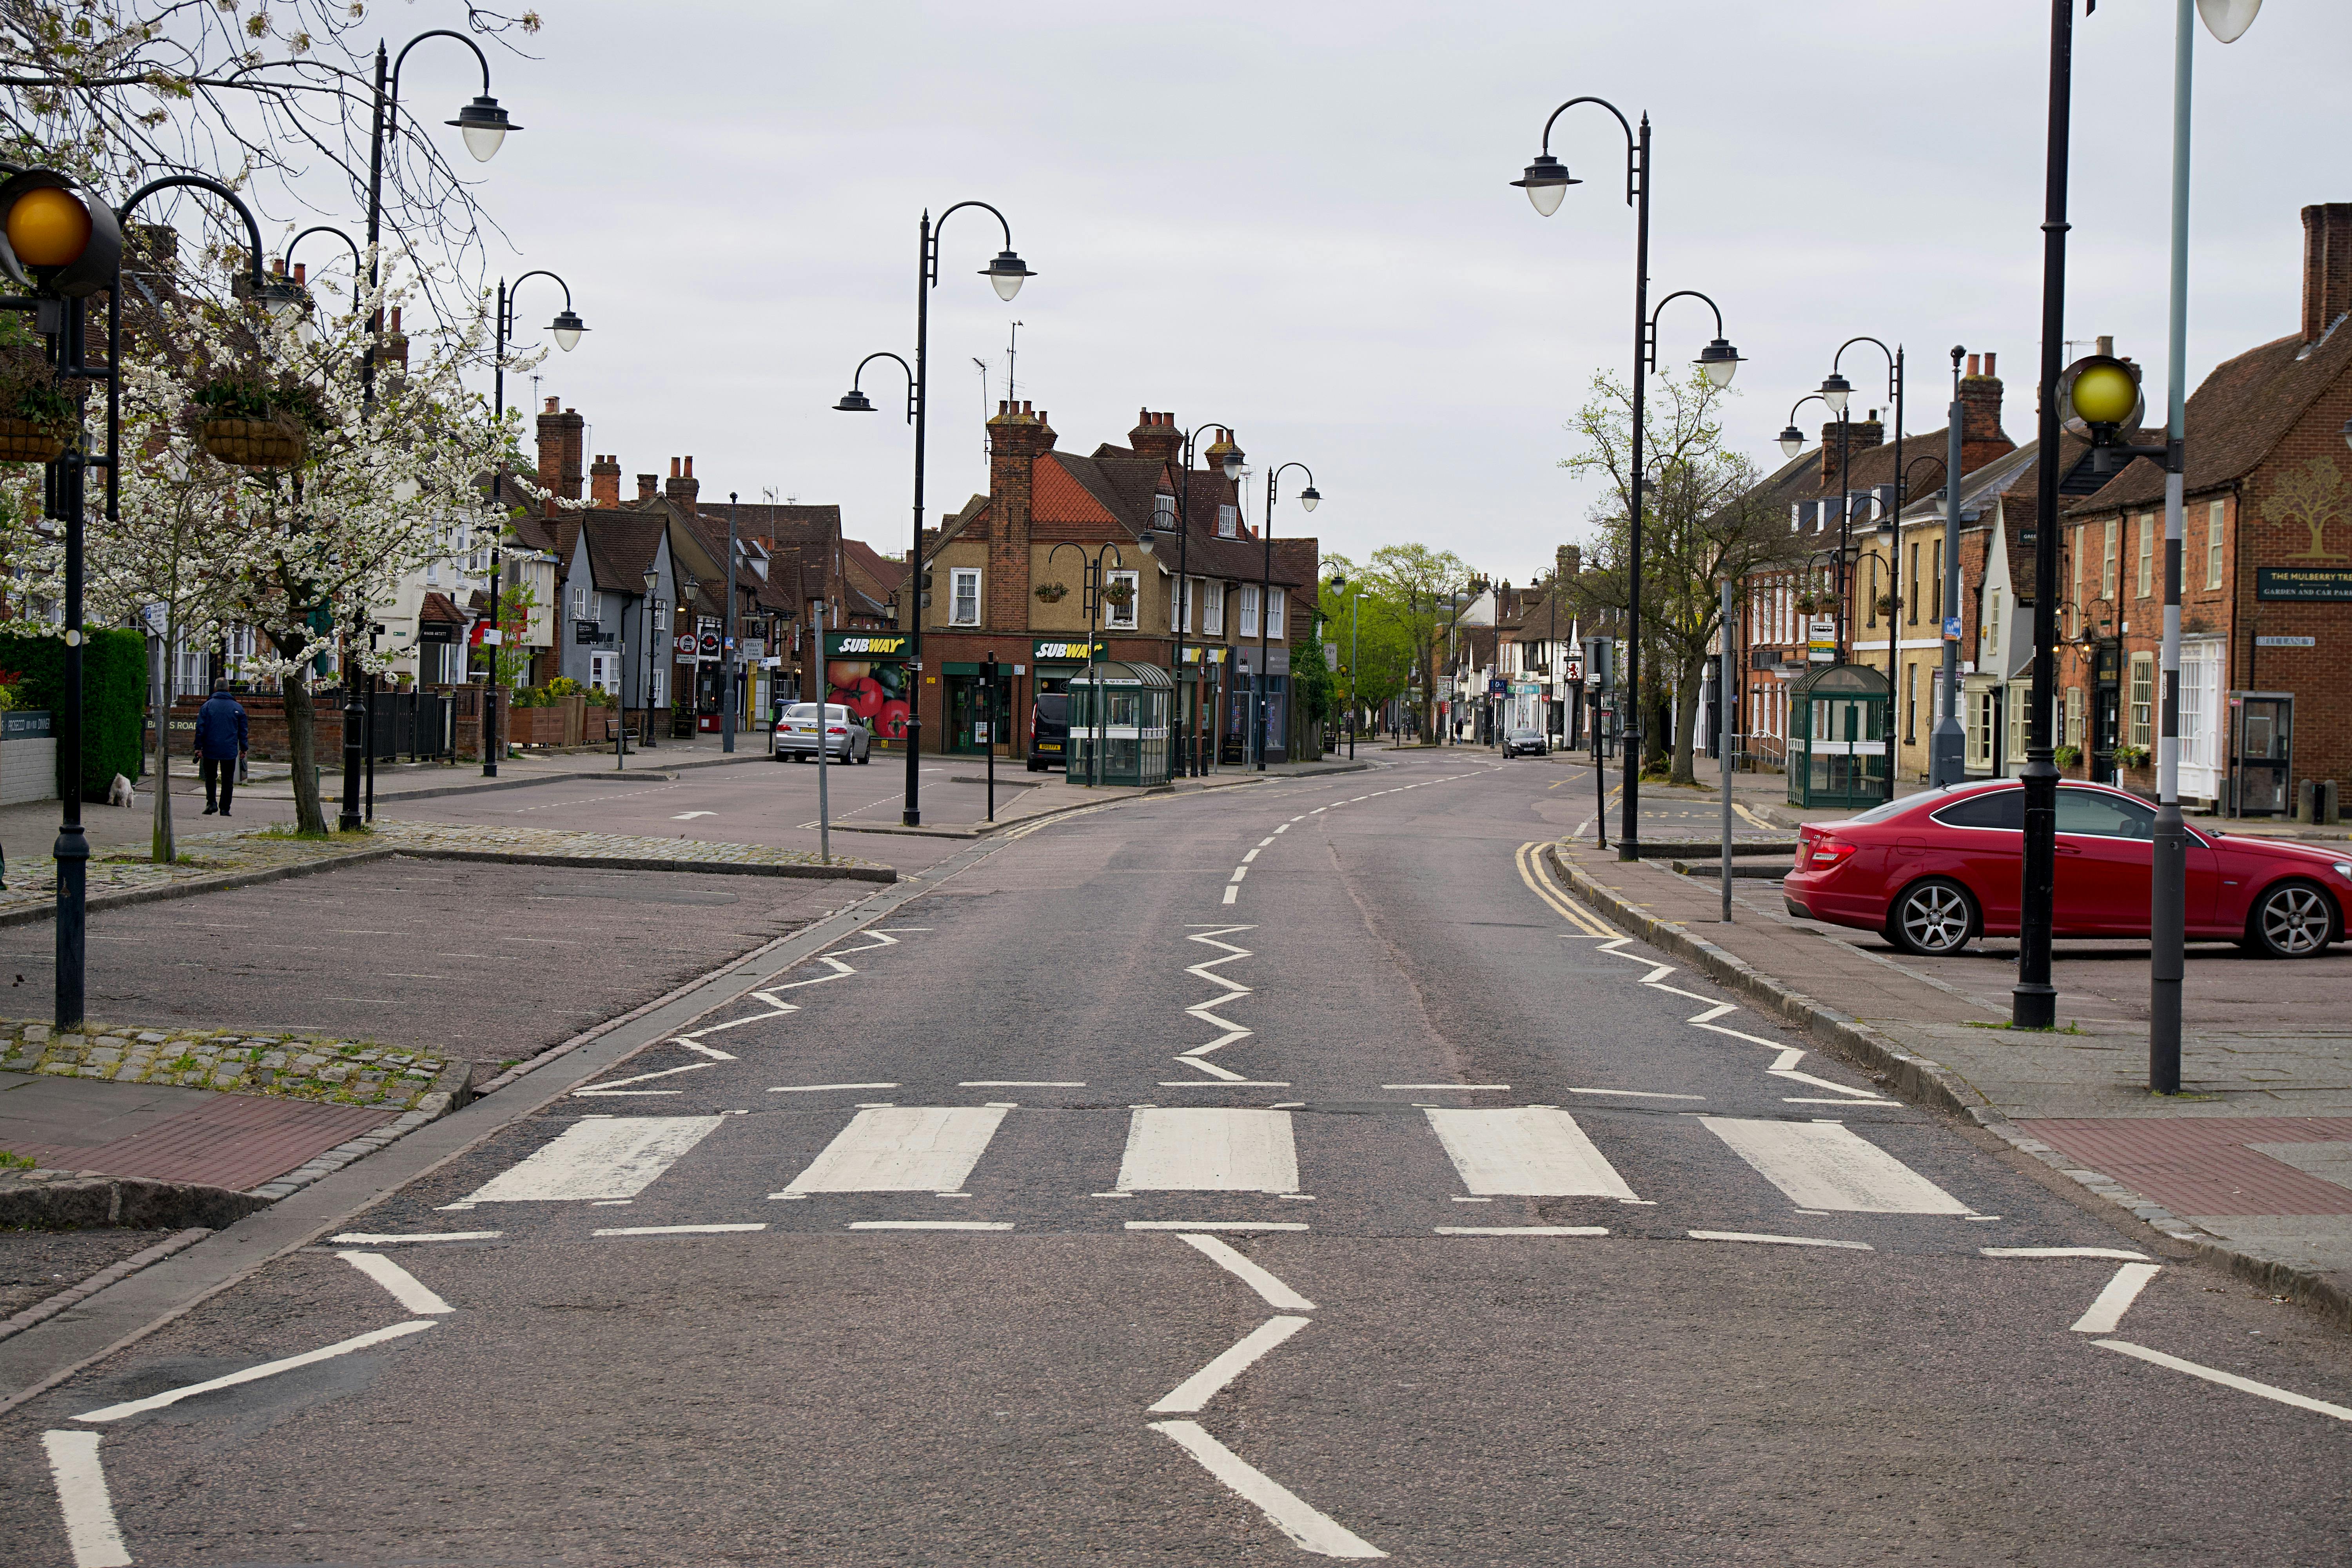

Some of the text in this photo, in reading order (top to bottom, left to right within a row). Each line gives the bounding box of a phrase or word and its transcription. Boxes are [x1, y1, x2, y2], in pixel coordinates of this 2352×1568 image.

[2270, 572, 2352, 581] THE MULBERRY TRE
[701, 632, 719, 641] REVOLUTION
[838, 637, 906, 653] SUBWAY
[8, 719, 25, 731] PROSECCO
[38, 718, 50, 730] DINNER
